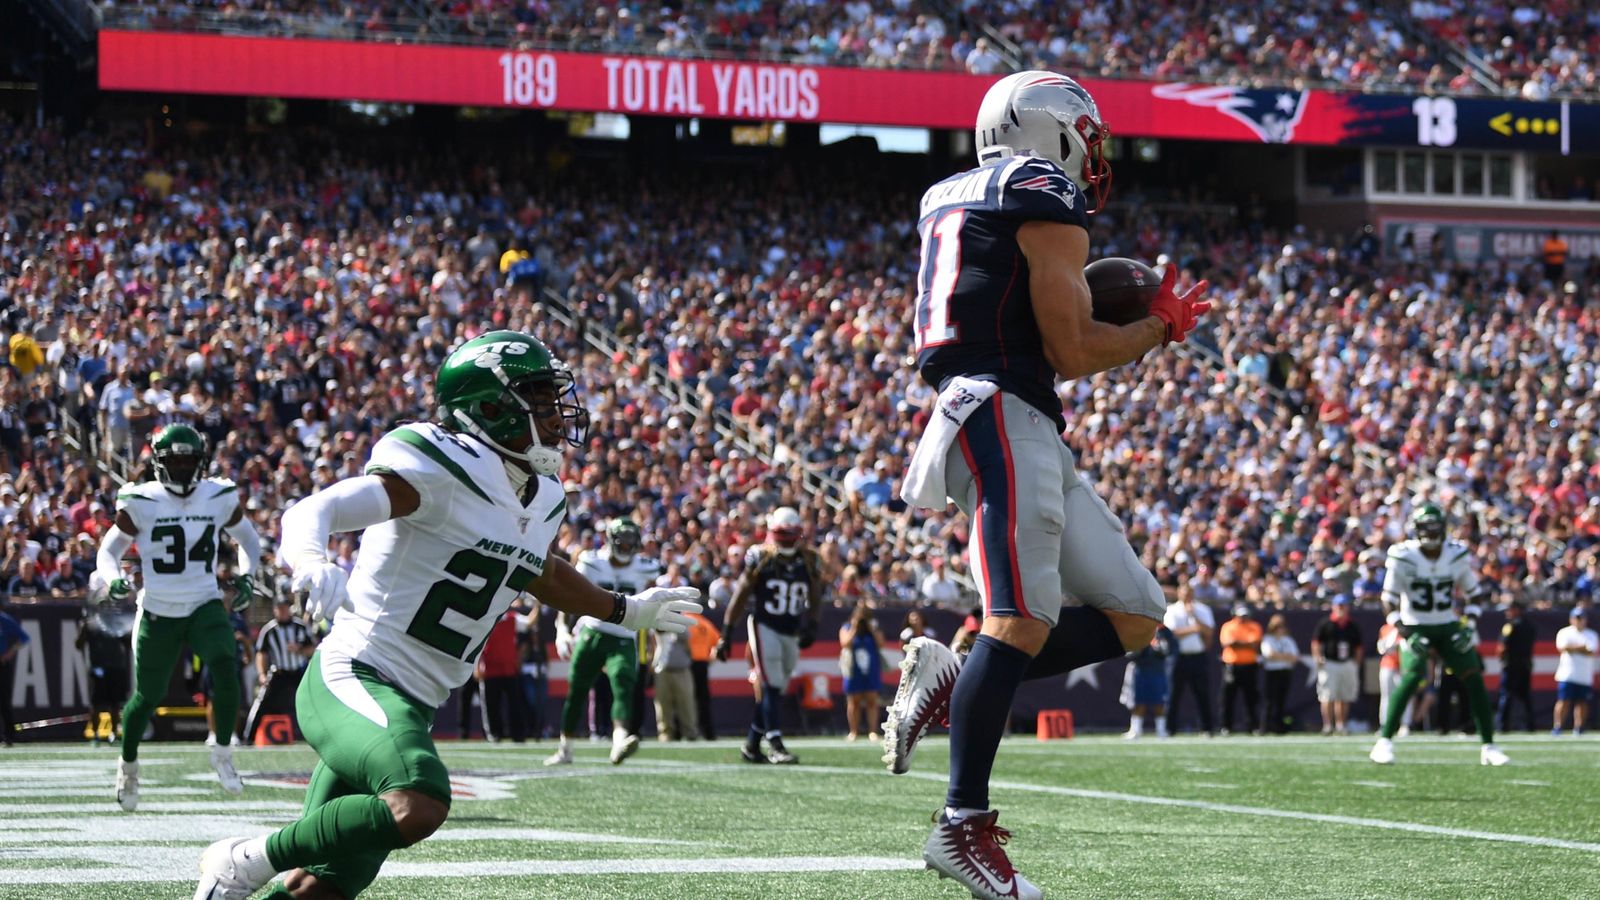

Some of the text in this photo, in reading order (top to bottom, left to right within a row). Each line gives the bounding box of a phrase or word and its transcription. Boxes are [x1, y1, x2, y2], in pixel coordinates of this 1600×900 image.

[500, 53, 557, 107] 189
[603, 58, 819, 119] TOTAL YARDS
[982, 128, 998, 147] 11
[1412, 96, 1458, 147] 13
[914, 207, 963, 349] 11
[151, 525, 215, 574] 34
[475, 538, 518, 556] NEW
[1410, 580, 1454, 612] 33
[264, 720, 289, 745] G
[1045, 715, 1069, 738] 10
